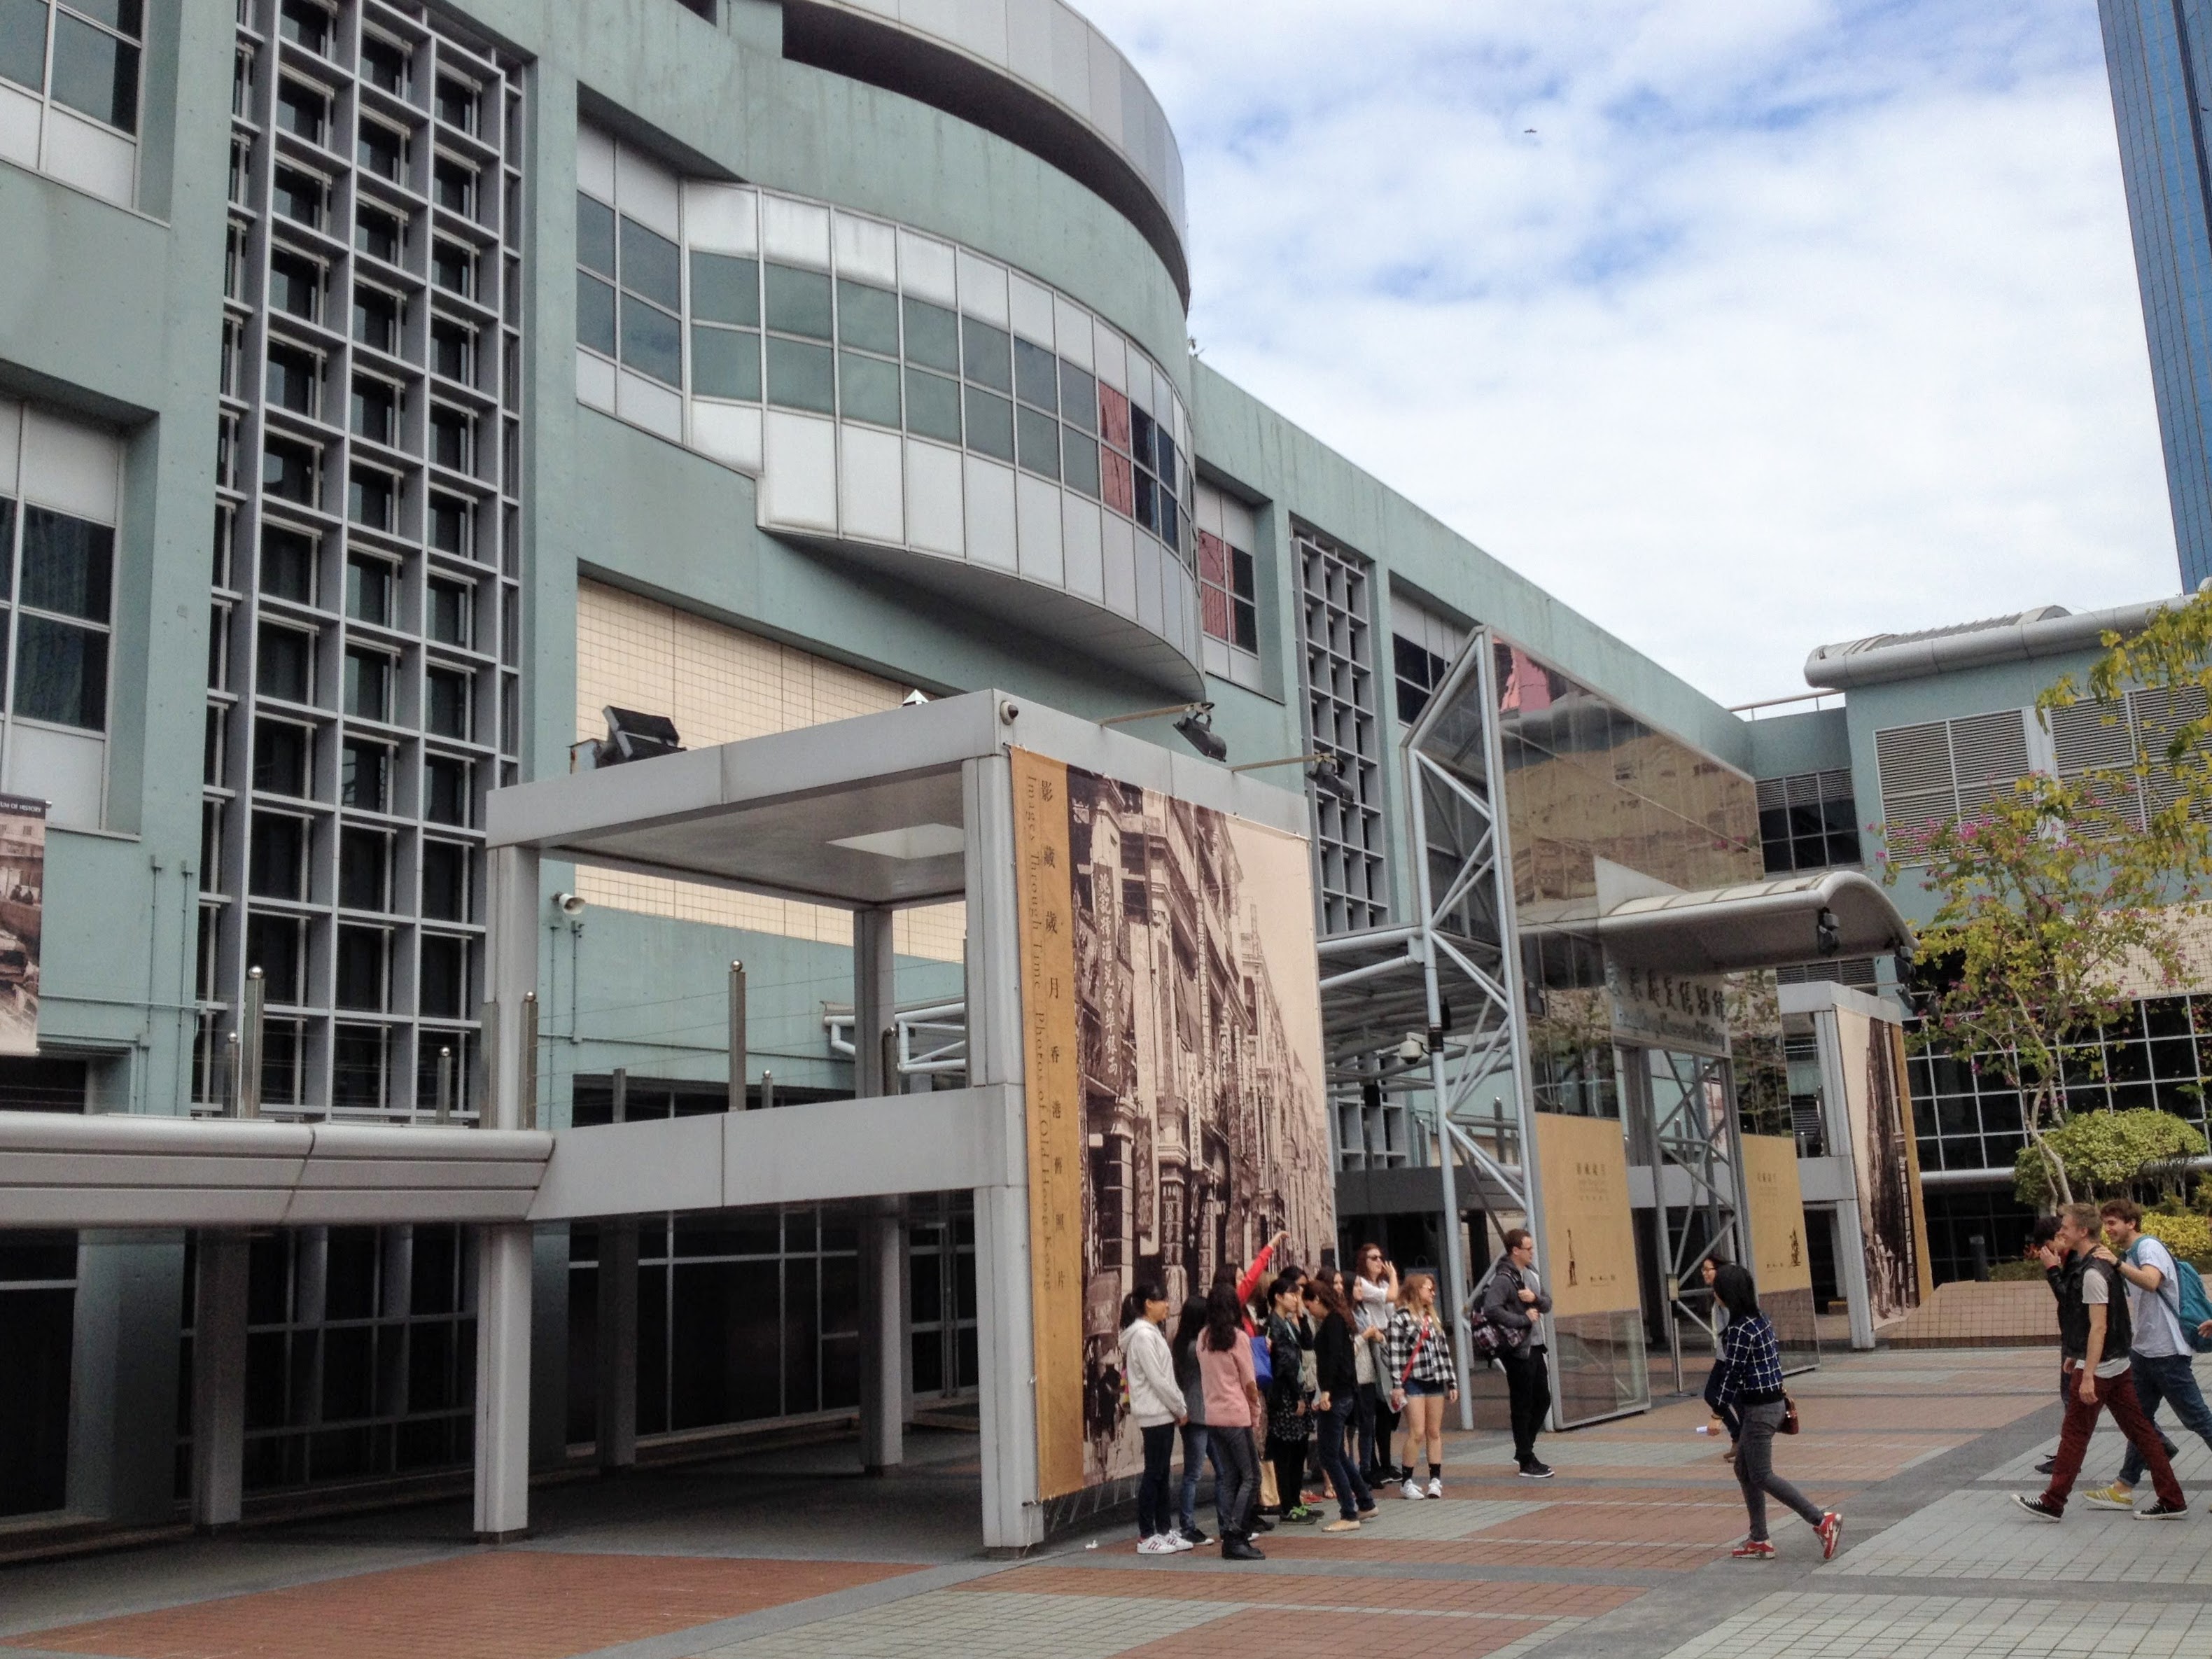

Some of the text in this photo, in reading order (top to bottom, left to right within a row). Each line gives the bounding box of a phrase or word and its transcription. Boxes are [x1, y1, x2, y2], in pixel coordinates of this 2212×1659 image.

[1026, 776, 1037, 842] Images
[1028, 853, 1042, 930] Through
[1032, 943, 1042, 990] Time
[1035, 1012, 1046, 1082] Photos
[1038, 1091, 1048, 1113] of
[1040, 1119, 1050, 1158] Old
